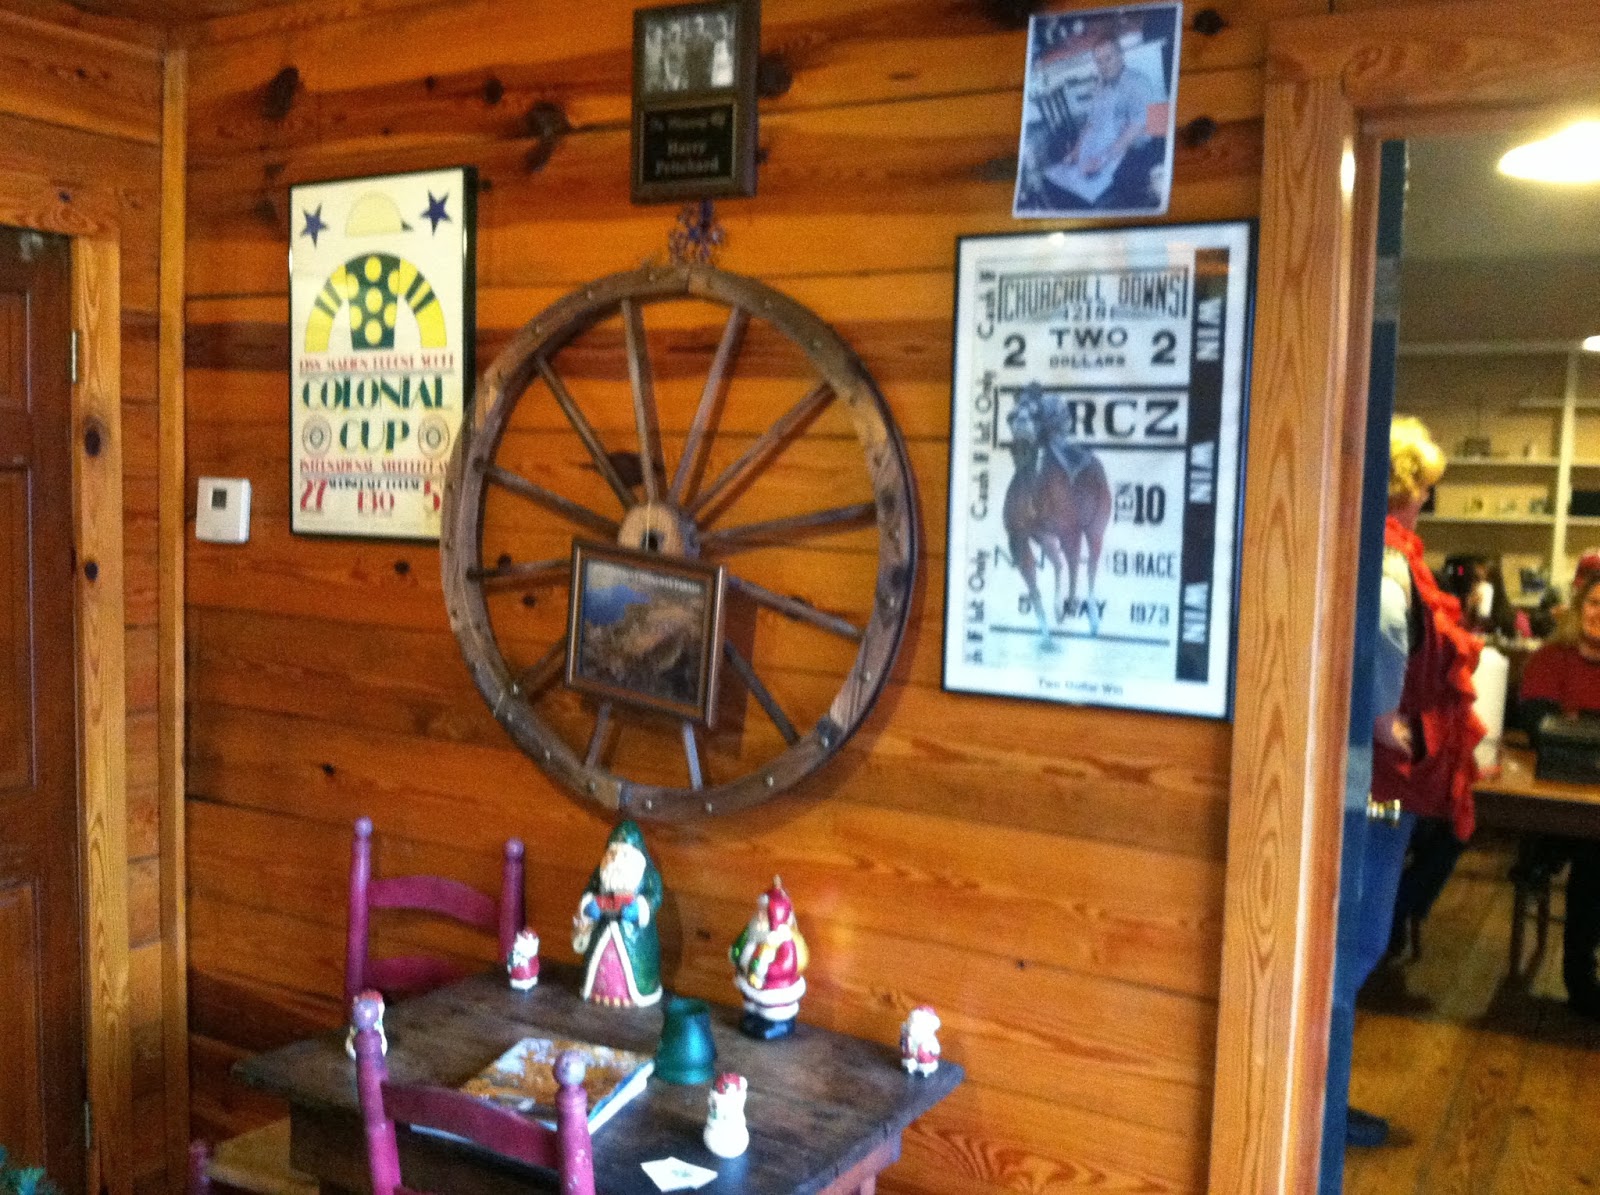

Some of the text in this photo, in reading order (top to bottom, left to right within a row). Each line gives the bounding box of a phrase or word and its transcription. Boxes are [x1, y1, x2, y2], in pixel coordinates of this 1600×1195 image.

[1004, 271, 1180, 321] CHURCHILL DOWNS
[1003, 327, 1177, 367] 2 TWO 2
[301, 372, 453, 409] COLONIAL
[339, 419, 410, 454] CUP
[1133, 484, 1166, 527] 10
[1135, 550, 1177, 578] RACE
[1130, 602, 1171, 626] 1973
